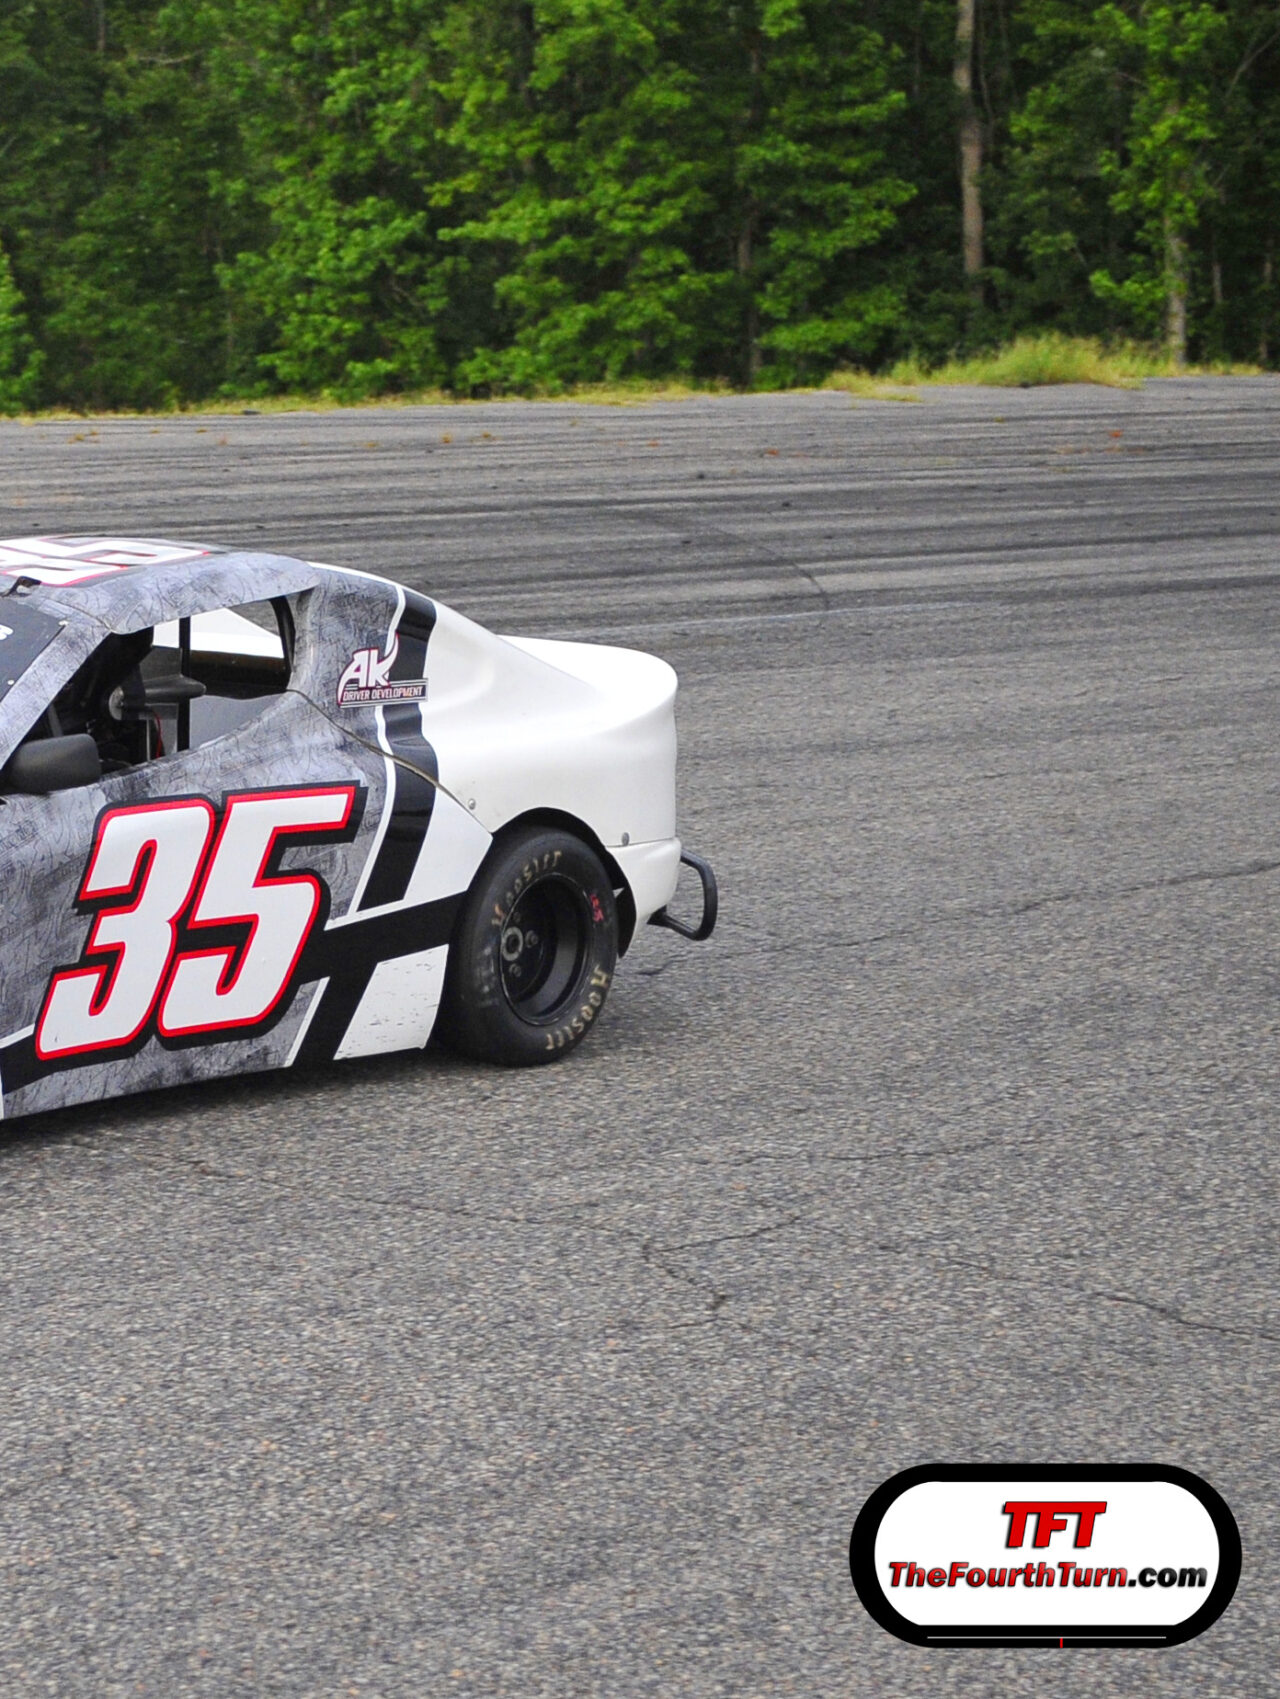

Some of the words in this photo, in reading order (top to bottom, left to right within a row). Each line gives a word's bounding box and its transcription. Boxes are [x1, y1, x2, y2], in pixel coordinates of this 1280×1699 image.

[337, 632, 400, 706] AK
[342, 690, 370, 701] DRIVER
[371, 686, 424, 700] DEVELOPMENT
[35, 785, 356, 1061] 35
